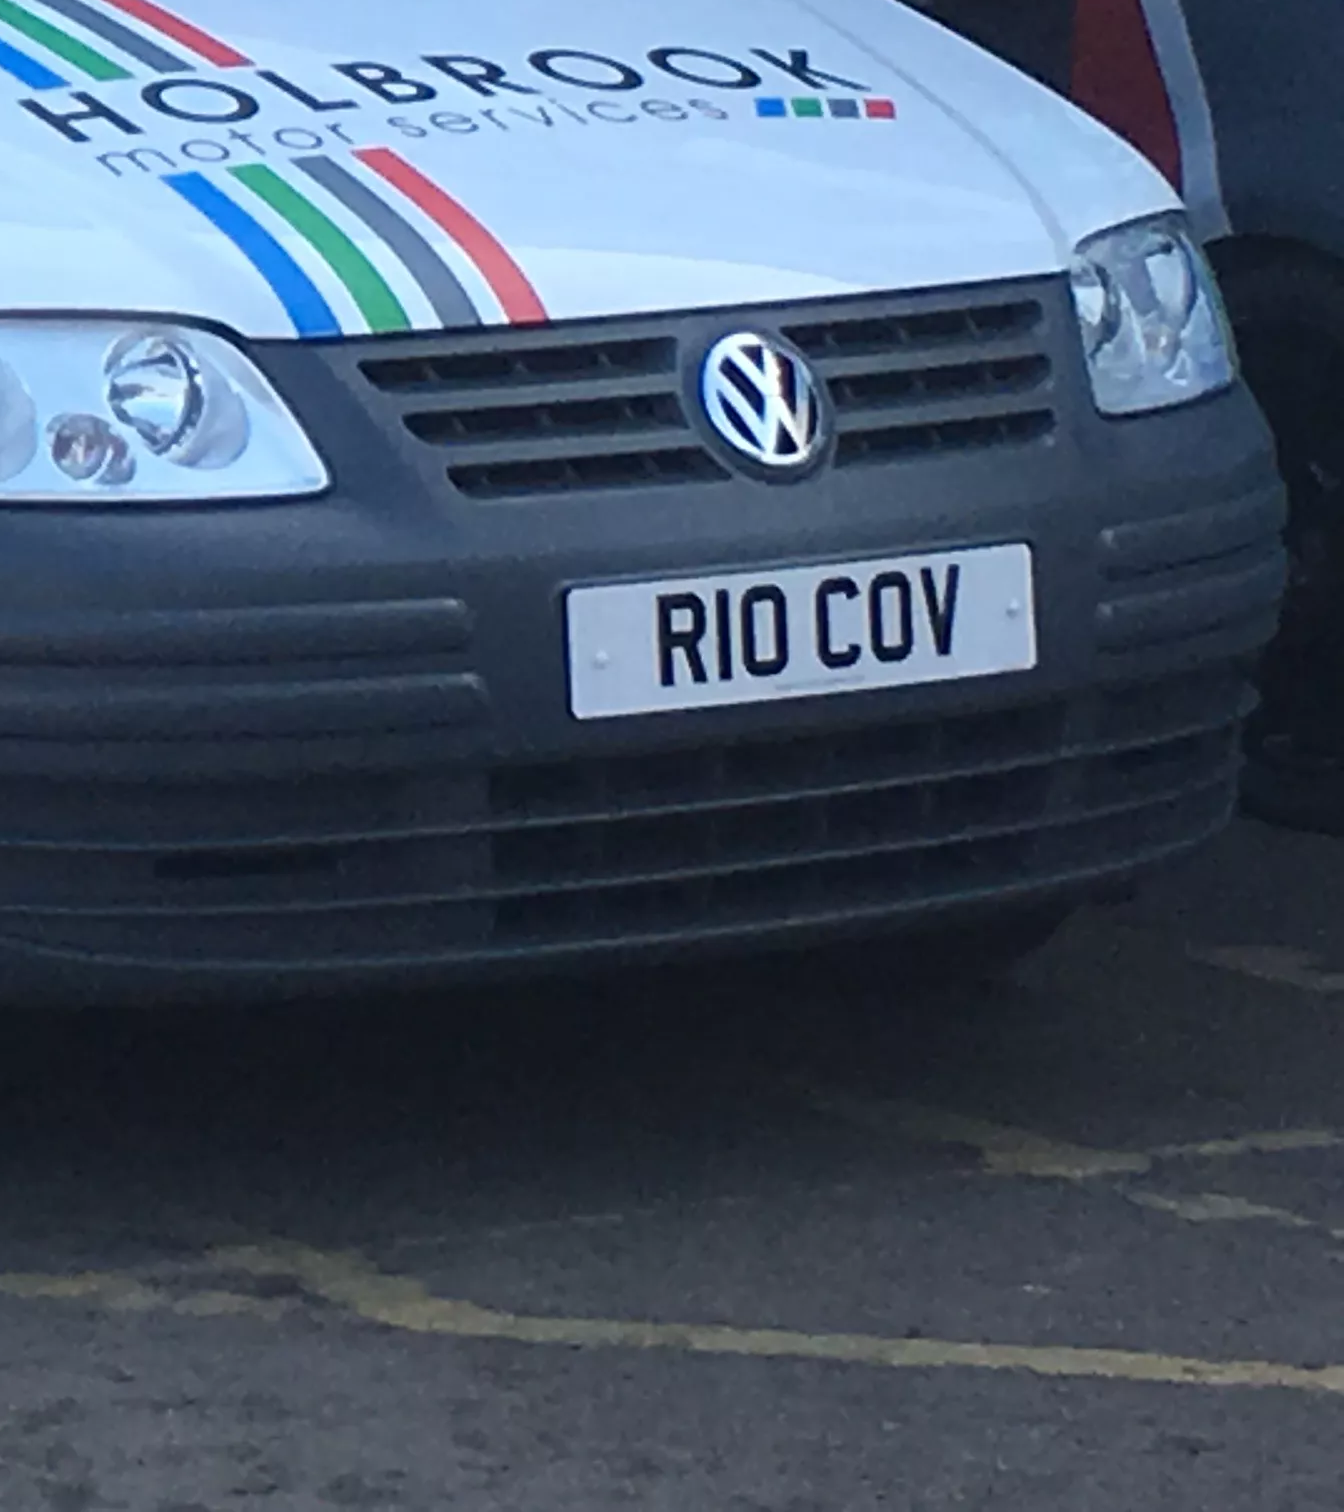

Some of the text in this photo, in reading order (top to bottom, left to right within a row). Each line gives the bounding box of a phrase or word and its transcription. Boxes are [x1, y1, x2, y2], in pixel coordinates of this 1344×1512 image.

[18, 46, 873, 143] HOLBROOK
[96, 96, 730, 177] motor services
[815, 563, 960, 670] COV
